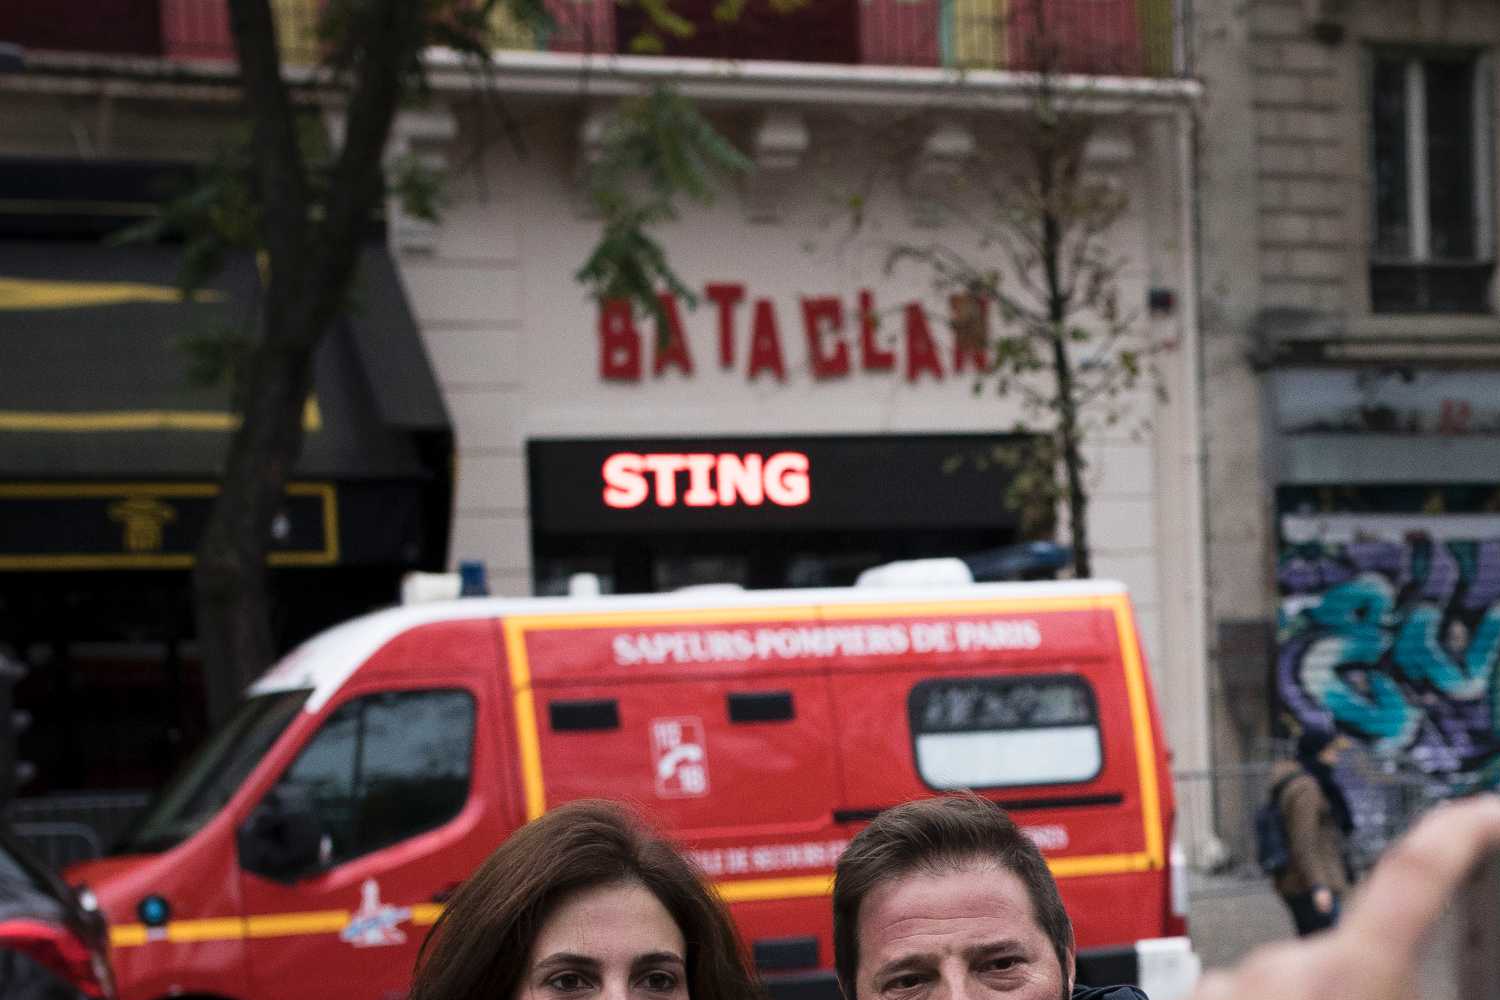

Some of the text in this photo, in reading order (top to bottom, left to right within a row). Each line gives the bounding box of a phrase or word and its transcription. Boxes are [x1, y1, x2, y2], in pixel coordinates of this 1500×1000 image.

[599, 282, 994, 384] BATACLAN
[601, 451, 811, 509] STING
[911, 623, 954, 652] DE
[956, 620, 1041, 650] PARIS
